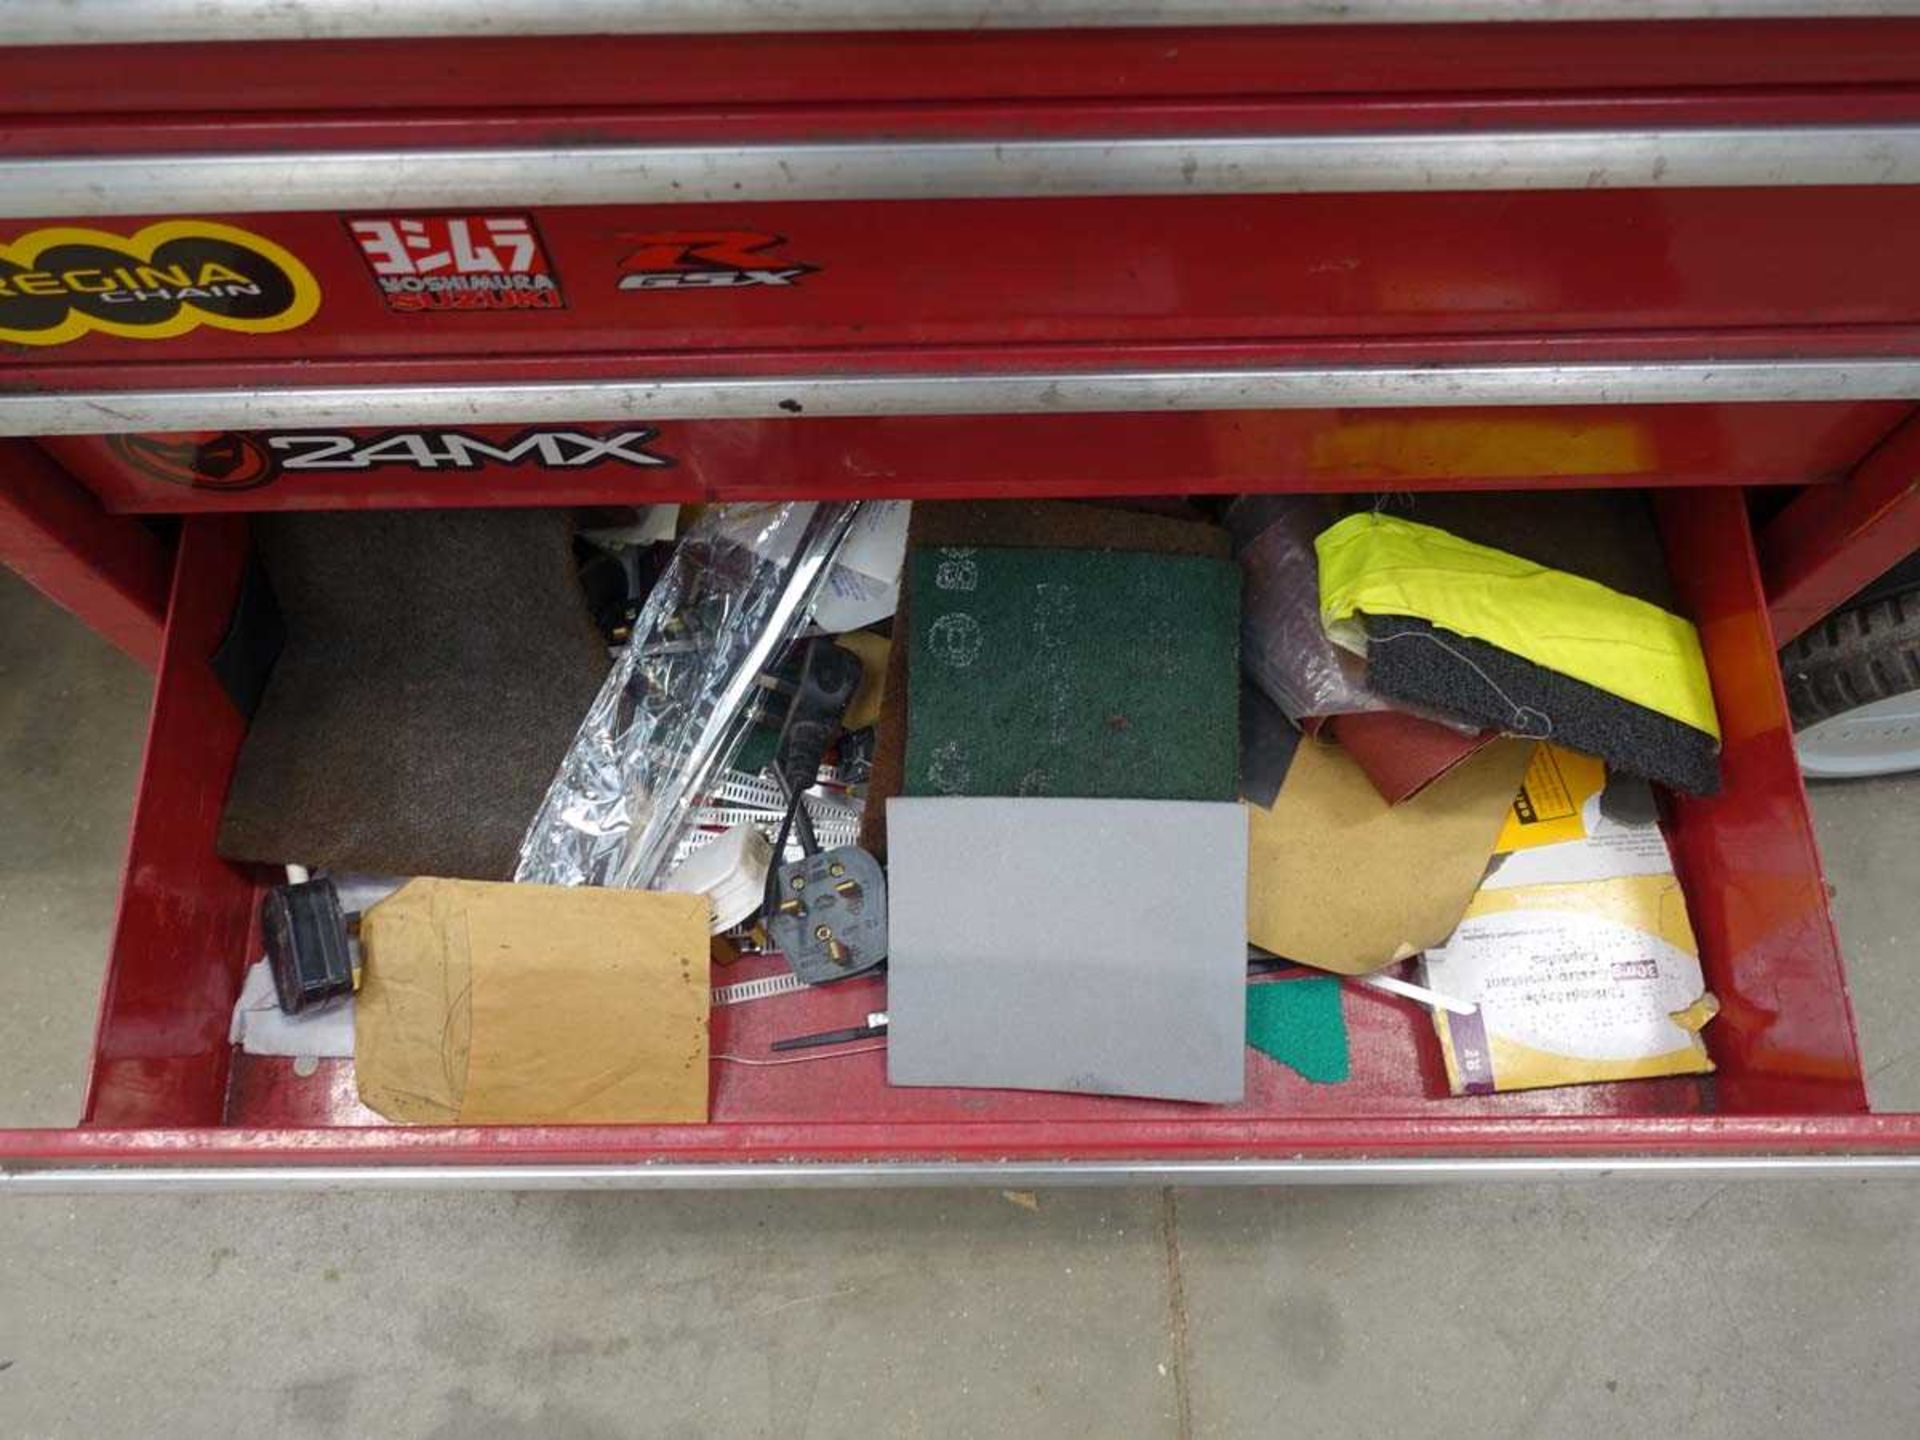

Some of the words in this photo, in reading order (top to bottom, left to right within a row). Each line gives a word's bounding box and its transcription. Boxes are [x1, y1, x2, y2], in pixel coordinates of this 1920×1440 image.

[351, 219, 535, 274] ヨシムラ
[378, 274, 557, 293] YOSHIMURA
[618, 269, 802, 290] GSX
[101, 283, 262, 303] CHAIN
[387, 290, 562, 310] SUZUKI
[268, 431, 665, 468] 24MX
